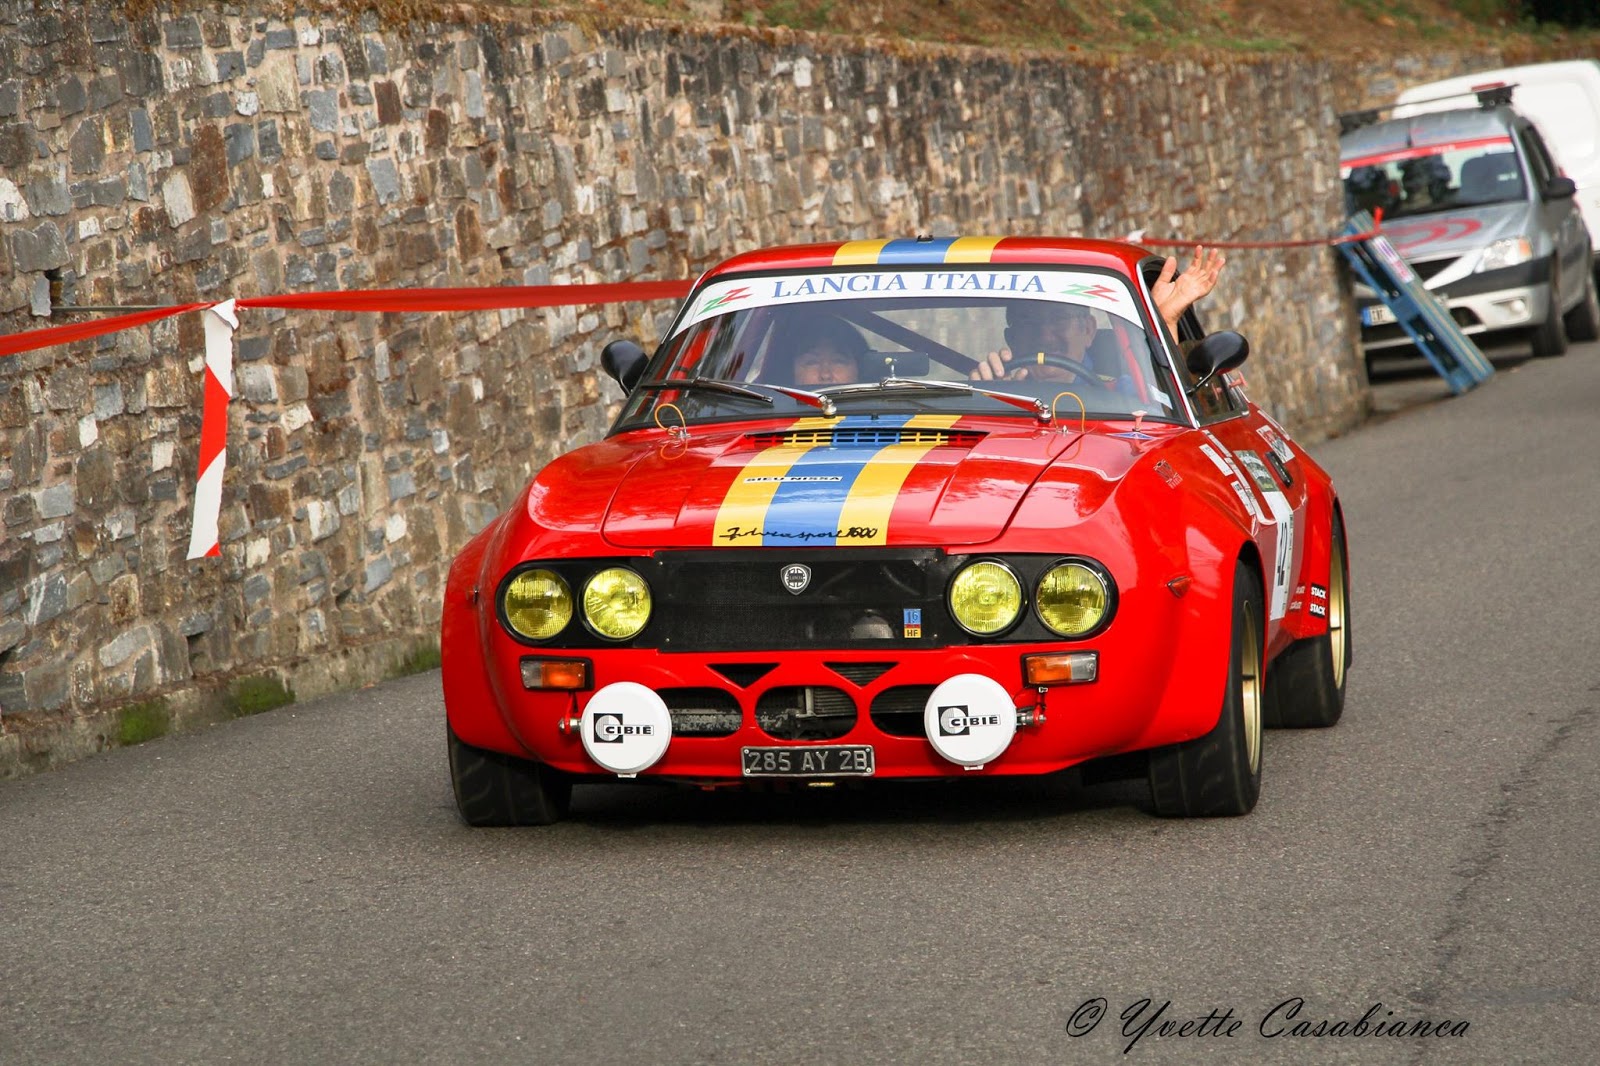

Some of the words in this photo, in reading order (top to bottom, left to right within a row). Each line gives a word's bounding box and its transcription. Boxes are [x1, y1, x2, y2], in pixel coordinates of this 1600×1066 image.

[772, 274, 906, 298] LANCIA
[924, 273, 1047, 293] ITALIA
[1311, 586, 1326, 599] STACK
[1310, 603, 1326, 615] STACK
[748, 751, 791, 771] 285
[801, 751, 829, 771] AY
[839, 750, 868, 770] 2B
